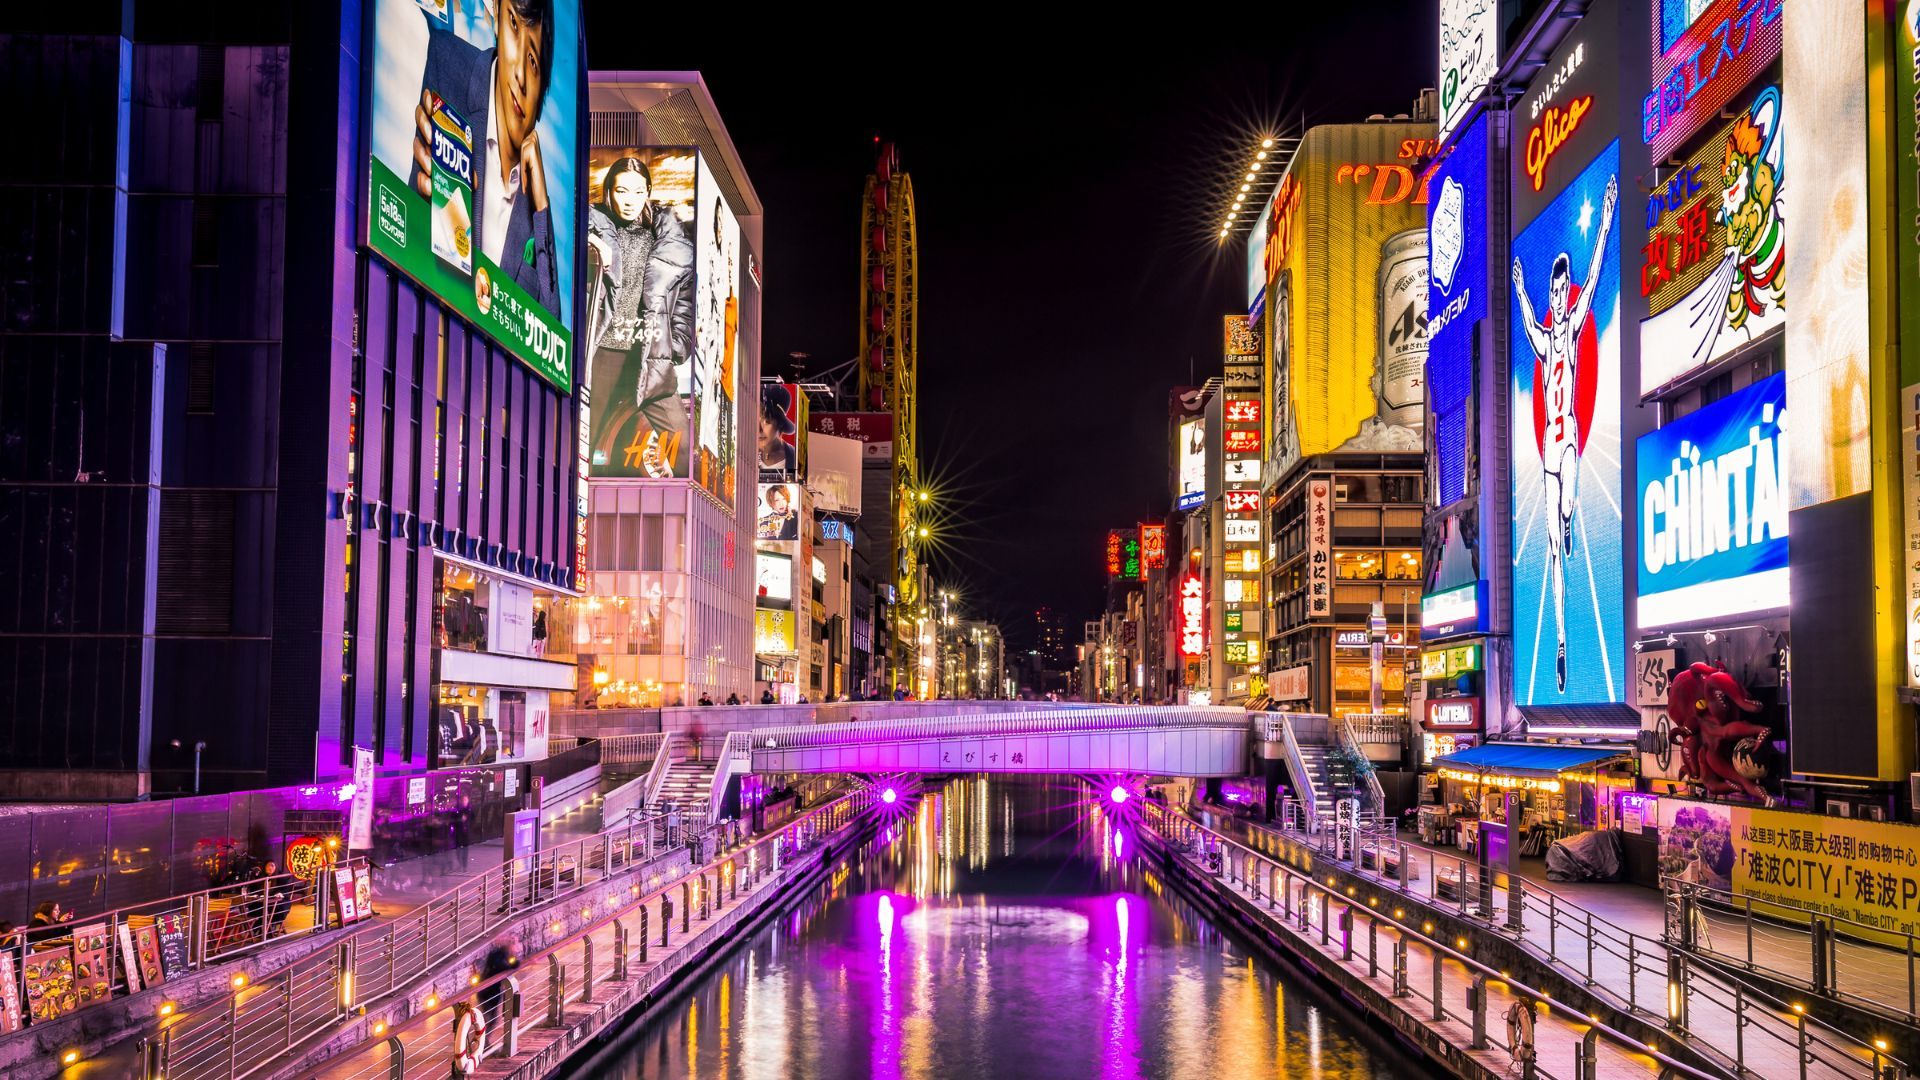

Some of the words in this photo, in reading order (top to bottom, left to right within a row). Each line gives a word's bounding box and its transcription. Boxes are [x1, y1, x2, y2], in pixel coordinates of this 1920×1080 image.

[434, 129, 472, 184] サロンパス
[1527, 96, 1591, 191] Glico
[1646, 163, 1703, 230] かぜに
[1640, 194, 1709, 298] 改源
[524, 308, 568, 378] サロンパス
[613, 318, 662, 329] ジャケット
[613, 328, 663, 344] ¥7,499
[1552, 354, 1565, 443] グリコ
[623, 430, 683, 469] H&M
[1314, 501, 1326, 545] 本場の味
[942, 751, 1023, 764] えびす橋
[1741, 824, 1918, 867] 从这里到大阪最大级别的购物中心
[1740, 847, 1920, 911] 「难波CITY」「难波P
[1762, 889, 1776, 902] class
[1803, 900, 1821, 912] center
[1823, 902, 1829, 914] in
[1900, 922, 1914, 935] and
